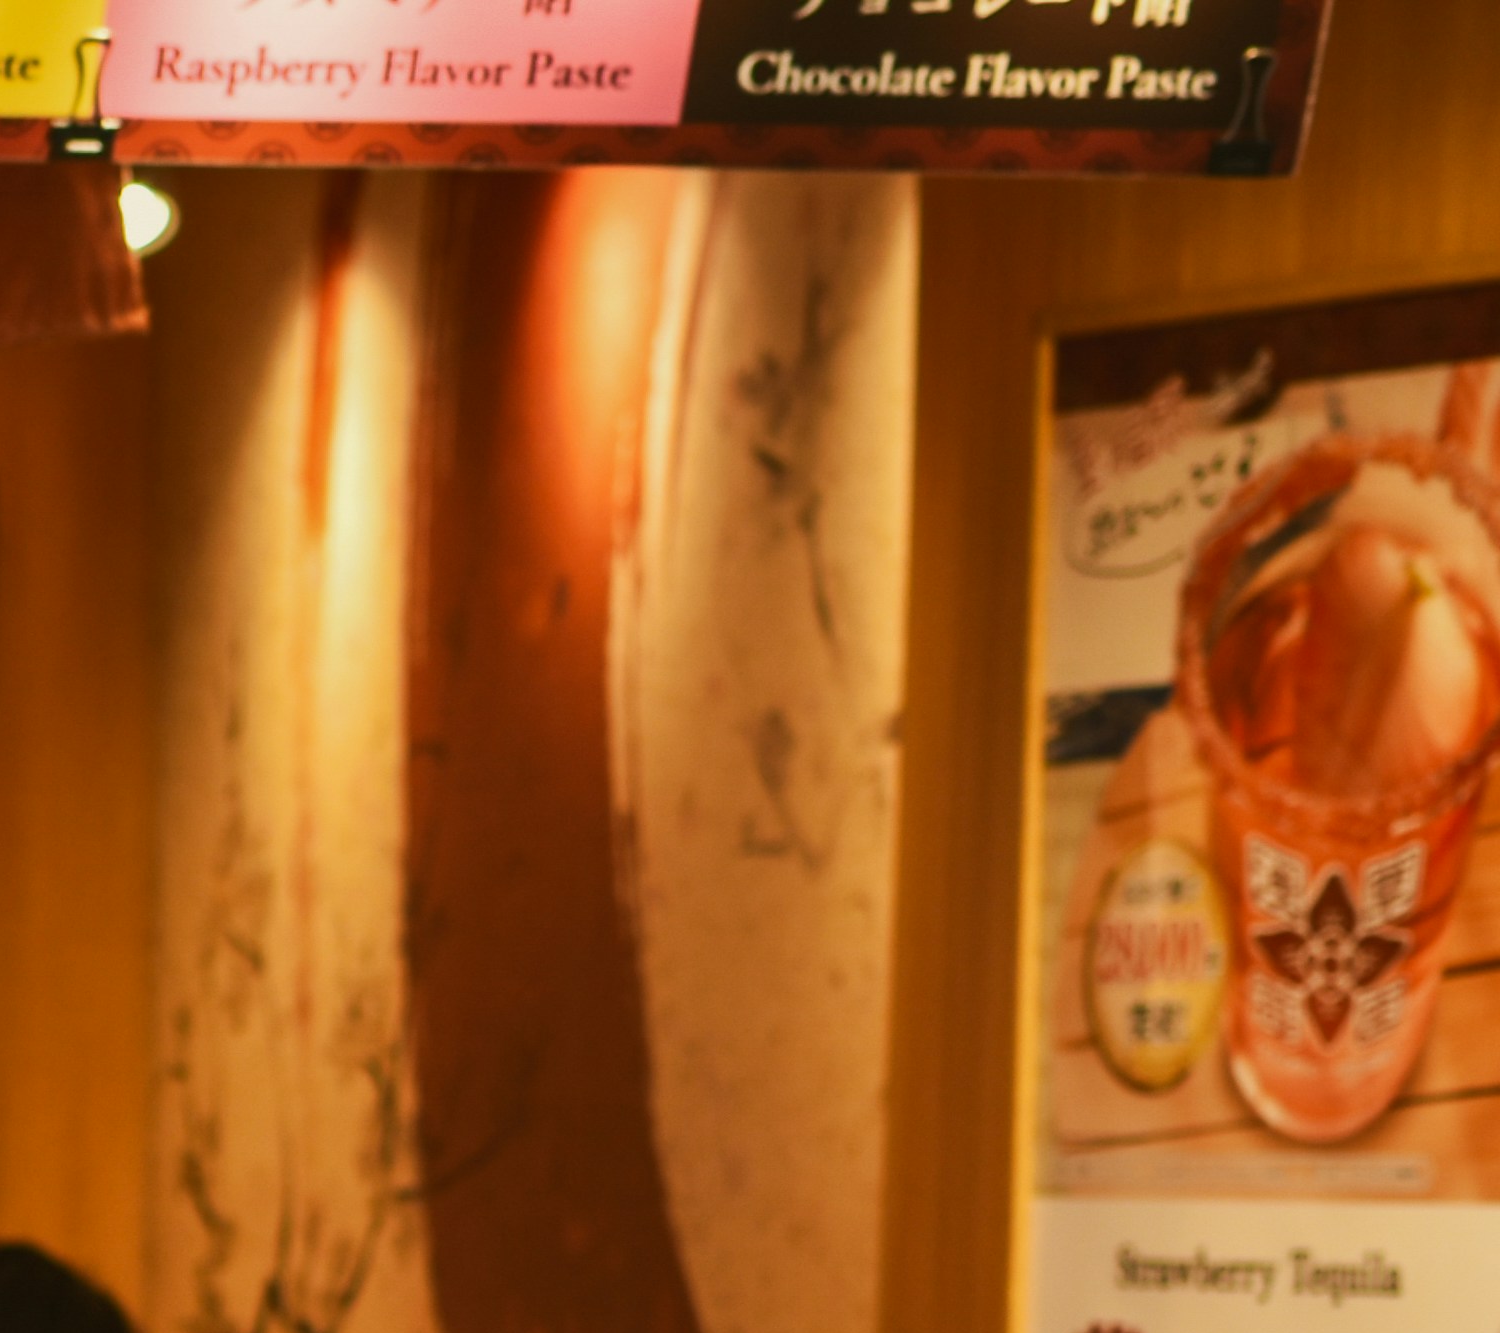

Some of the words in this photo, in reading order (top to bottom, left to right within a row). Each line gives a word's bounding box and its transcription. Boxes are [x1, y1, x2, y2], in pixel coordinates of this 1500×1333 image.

[152, 40, 366, 102] Raspberry
[381, 46, 510, 90] Flavor
[526, 50, 632, 92] Paste
[737, 50, 955, 98] Chocolate
[962, 52, 1100, 100] Flavor
[1106, 54, 1218, 102] Paste
[1115, 1243, 1278, 1305] Strawberry
[1290, 1246, 1404, 1308] Tequila
